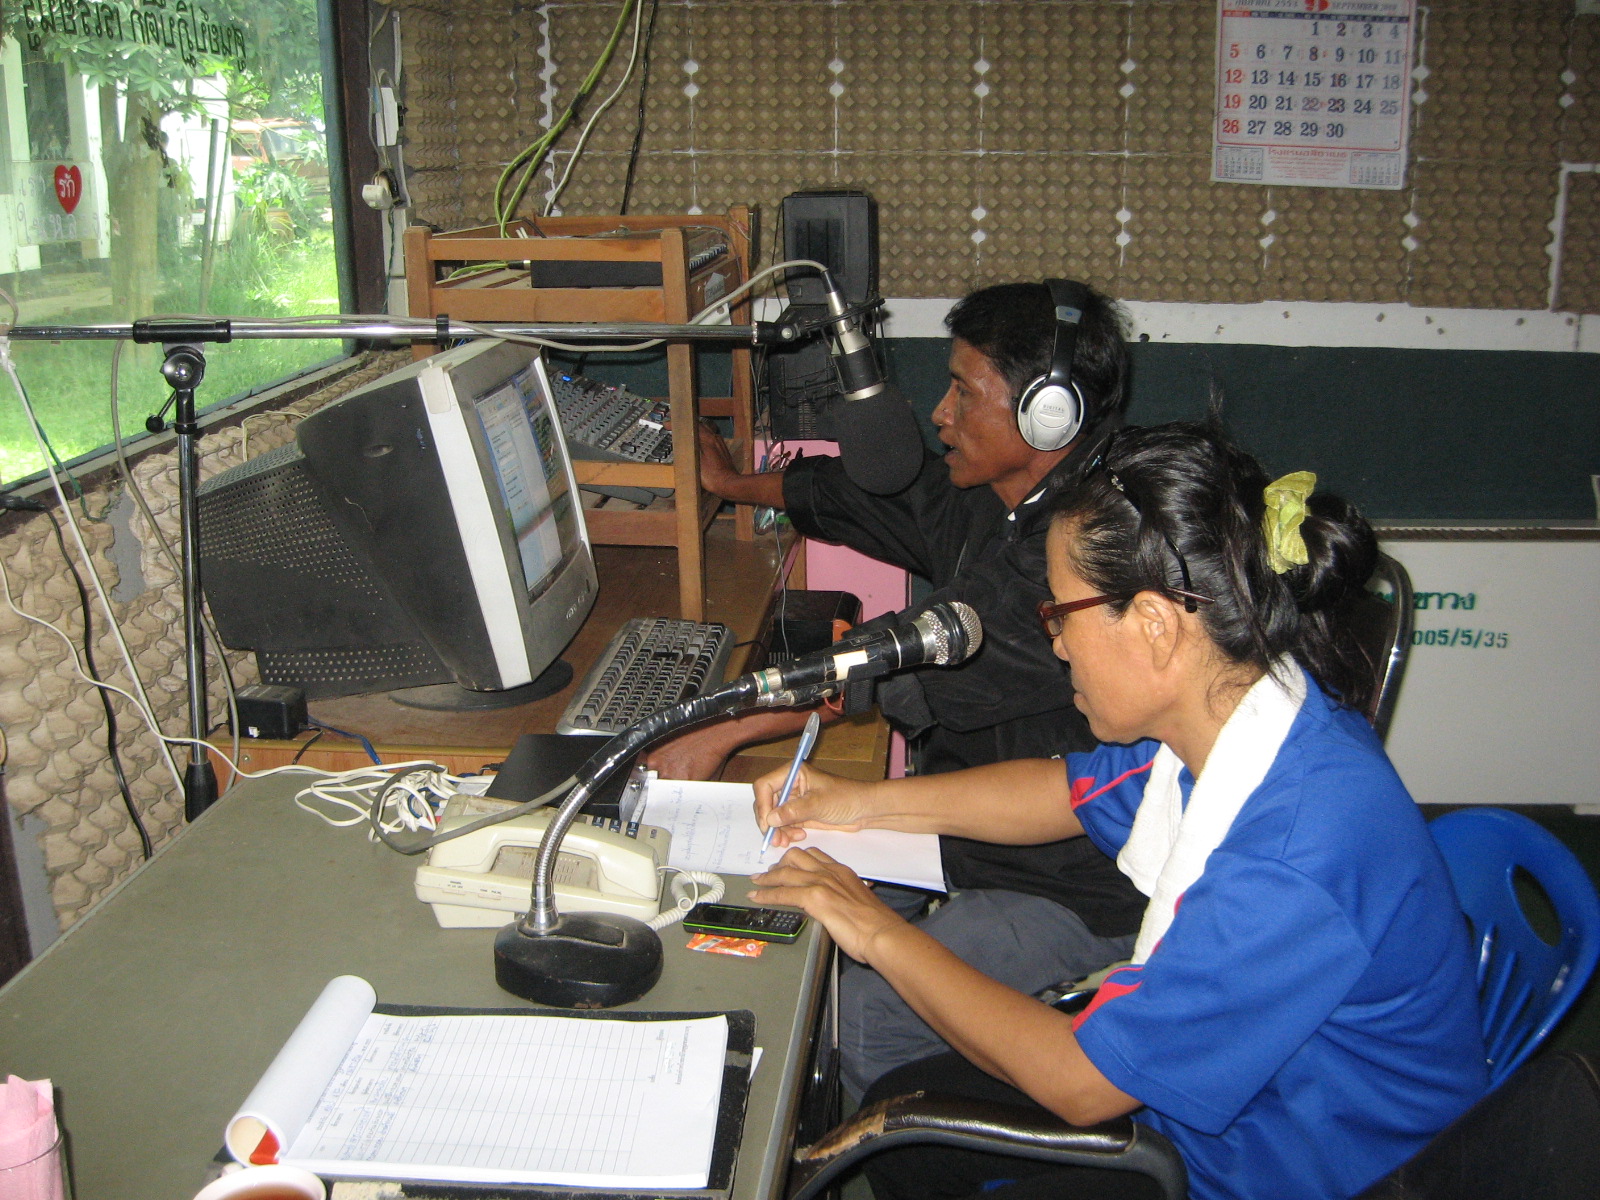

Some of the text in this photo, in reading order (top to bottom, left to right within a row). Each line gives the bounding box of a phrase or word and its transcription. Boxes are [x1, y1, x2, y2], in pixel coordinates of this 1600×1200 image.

[1311, 22, 1400, 39] 1 2 3 4
[1230, 44, 1400, 65] 5 6 7 8 9 10 11
[1225, 69, 1400, 90] 12 13 14 15 16 17 18
[1223, 95, 1398, 115] 19 20 21 22 23 24 25
[1223, 120, 1344, 138] 26 27 28 29 30
[58, 173, 76, 198] รัก
[1043, 404, 1065, 412] DIGITAL
